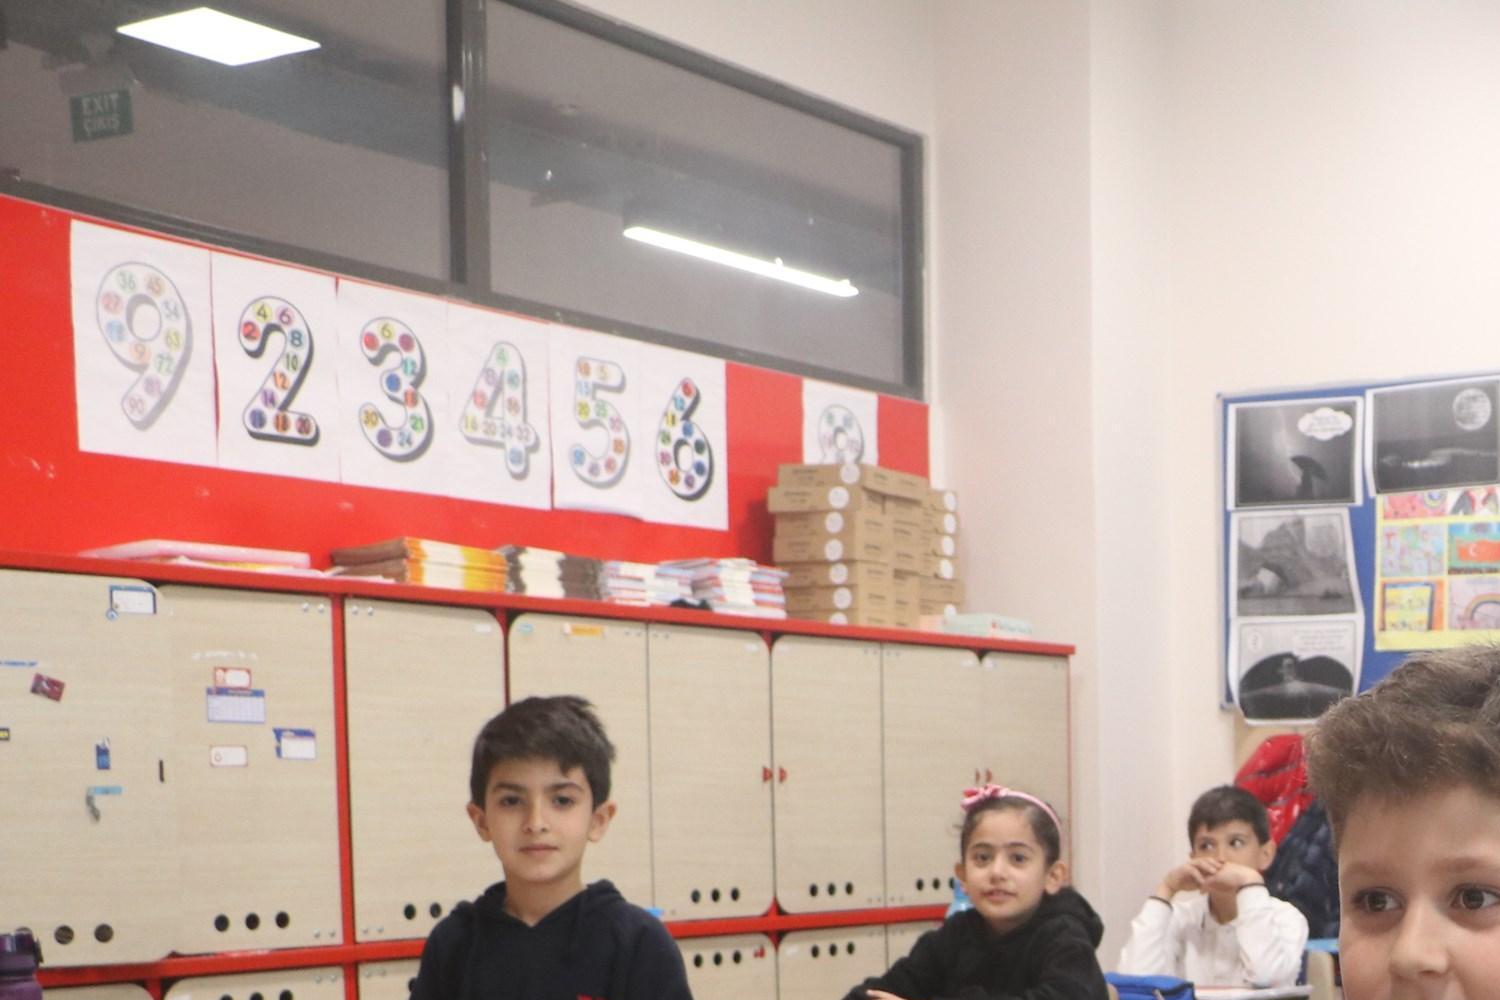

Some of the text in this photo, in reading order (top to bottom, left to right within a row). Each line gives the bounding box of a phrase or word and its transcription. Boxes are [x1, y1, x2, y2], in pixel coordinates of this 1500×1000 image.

[257, 304, 269, 320] 4
[279, 307, 292, 326] 6
[244, 321, 260, 342] 2
[289, 329, 304, 348] 8
[380, 322, 394, 341] 6
[96, 261, 193, 432] 9
[238, 296, 319, 447] 2
[285, 353, 299, 371] 10
[273, 371, 290, 391] 12
[359, 317, 434, 463] 3
[459, 340, 541, 481] 4
[571, 356, 631, 489] 5
[656, 377, 714, 502] 6
